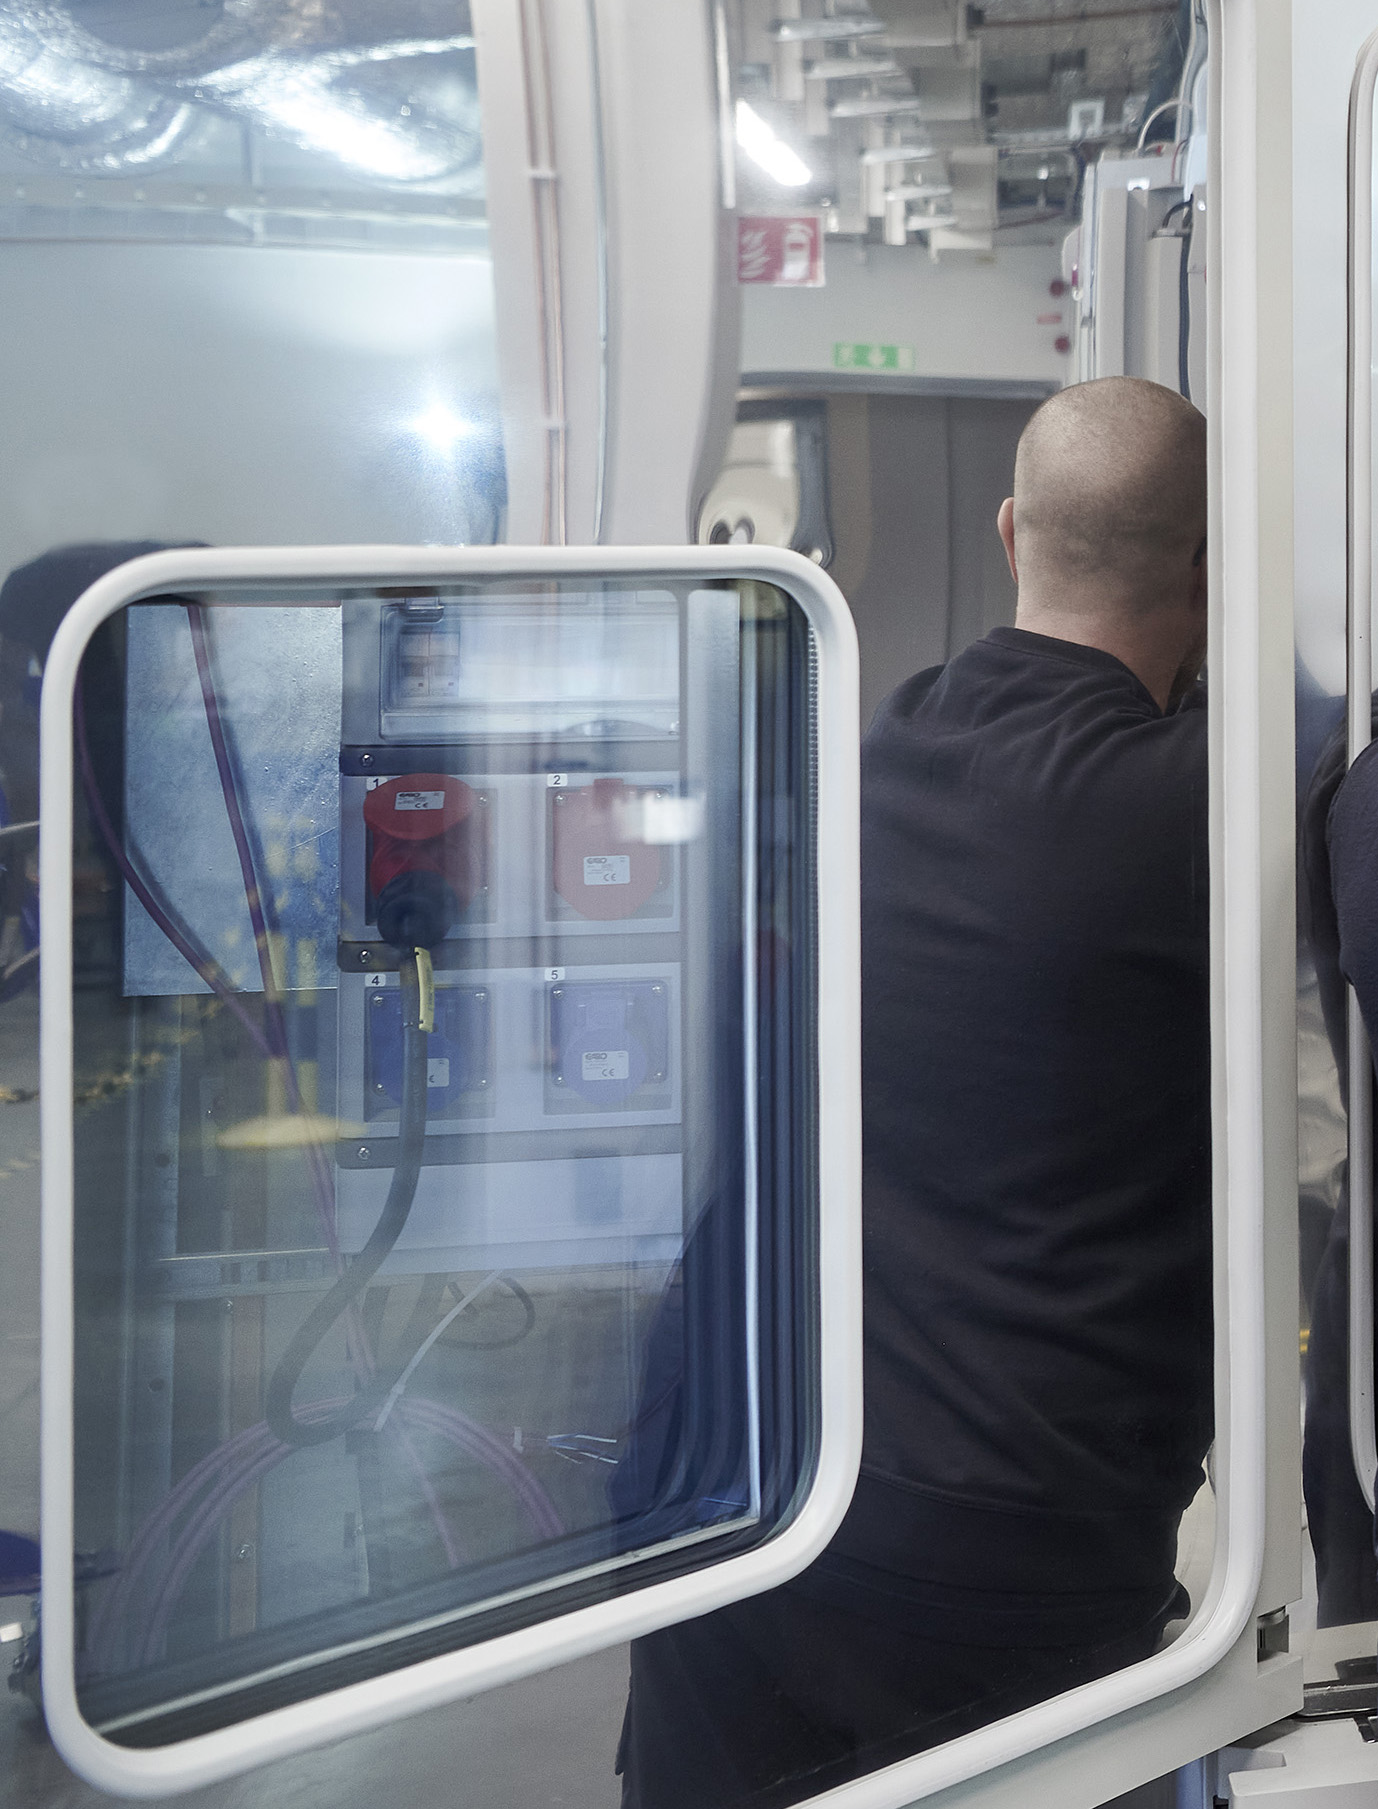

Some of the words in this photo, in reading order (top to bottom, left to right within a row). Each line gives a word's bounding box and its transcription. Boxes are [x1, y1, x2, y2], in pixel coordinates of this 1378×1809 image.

[373, 778, 379, 788] 1
[553, 774, 561, 785] 2
[551, 969, 559, 980] 5
[371, 975, 380, 986] 4
